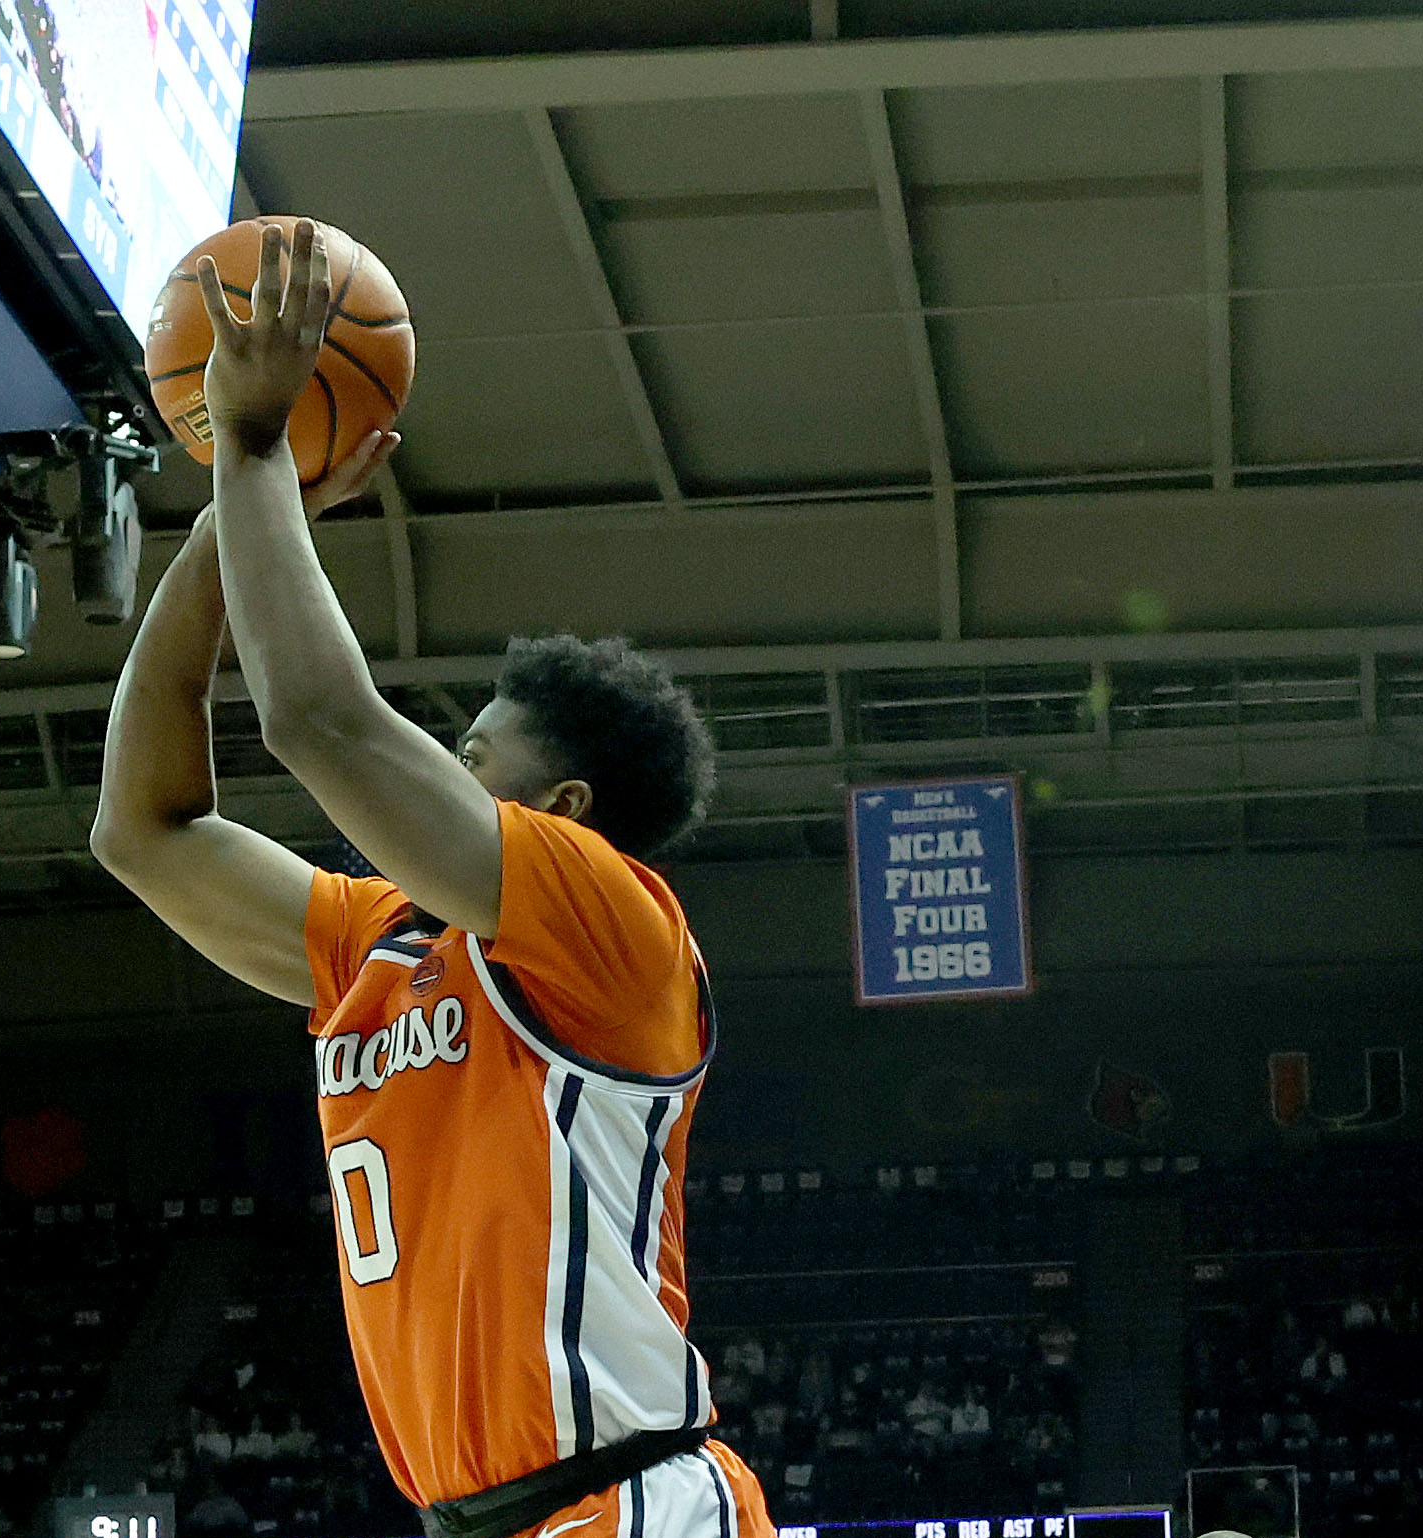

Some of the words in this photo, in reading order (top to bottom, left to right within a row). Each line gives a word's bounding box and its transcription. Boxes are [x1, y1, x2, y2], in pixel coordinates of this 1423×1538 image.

[888, 829, 984, 862] NCAA
[885, 867, 991, 900] FINAL
[893, 904, 988, 936] FOUR
[1003, 1519, 1034, 1538] AST
[1044, 1518, 1064, 1537] PF
